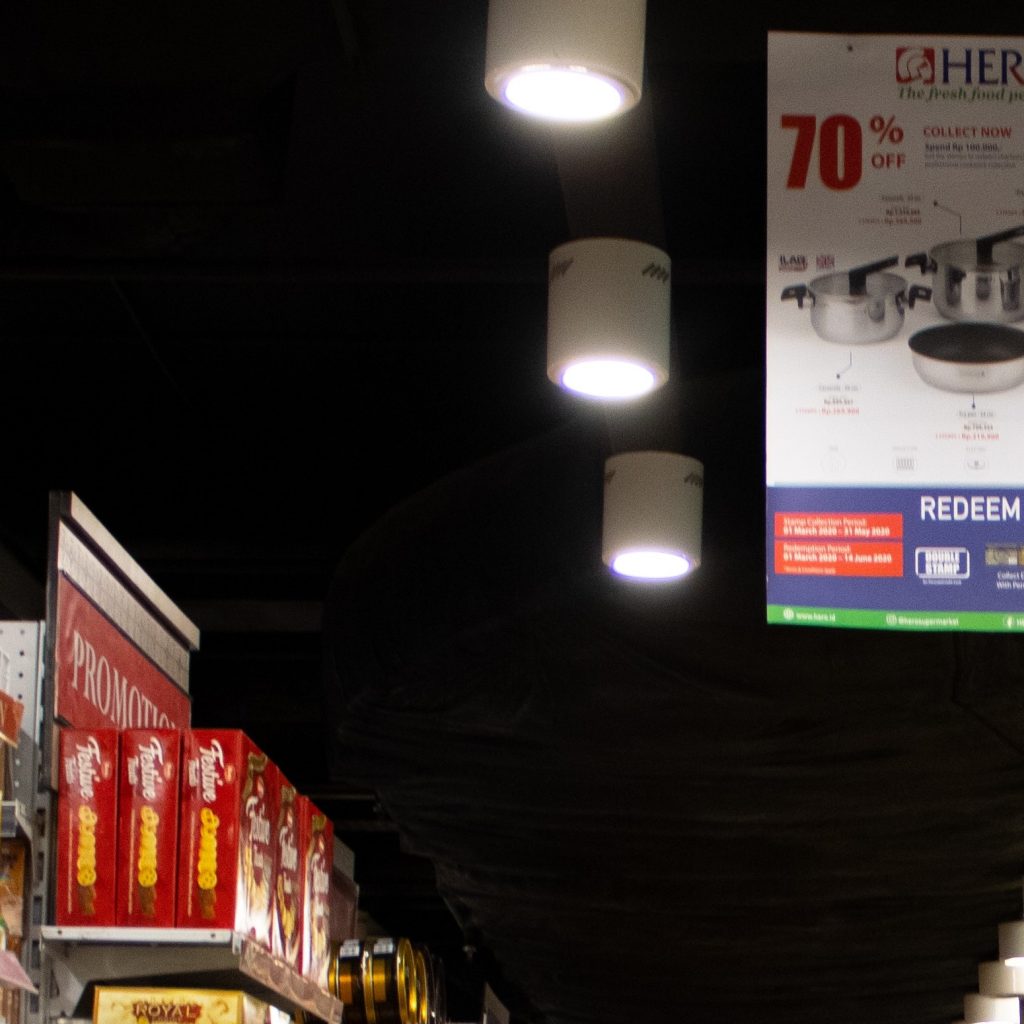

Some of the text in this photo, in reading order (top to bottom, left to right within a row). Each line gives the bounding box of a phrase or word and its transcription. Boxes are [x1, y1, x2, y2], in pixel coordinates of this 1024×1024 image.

[899, 86, 922, 100] The
[924, 86, 969, 102] fresh
[971, 86, 1004, 101] food
[923, 127, 1012, 138] COLLECT NOW
[781, 114, 905, 191] 70 %
[871, 153, 905, 169] OFF
[920, 495, 1021, 522] REDEEM
[794, 527, 818, 536] March
[818, 527, 838, 536] 2020
[854, 527, 871, 538] May
[871, 527, 891, 536] 2020
[794, 553, 818, 562] March
[819, 553, 838, 562] 2020
[855, 554, 873, 563] June
[873, 554, 893, 563] 2020
[925, 551, 960, 562] DOUBLE
[925, 563, 960, 575] STAMP
[76, 736, 102, 800] Festive
[138, 737, 165, 801] Festive
[199, 739, 225, 803] Festive
[135, 1004, 198, 1018] ROYAL
